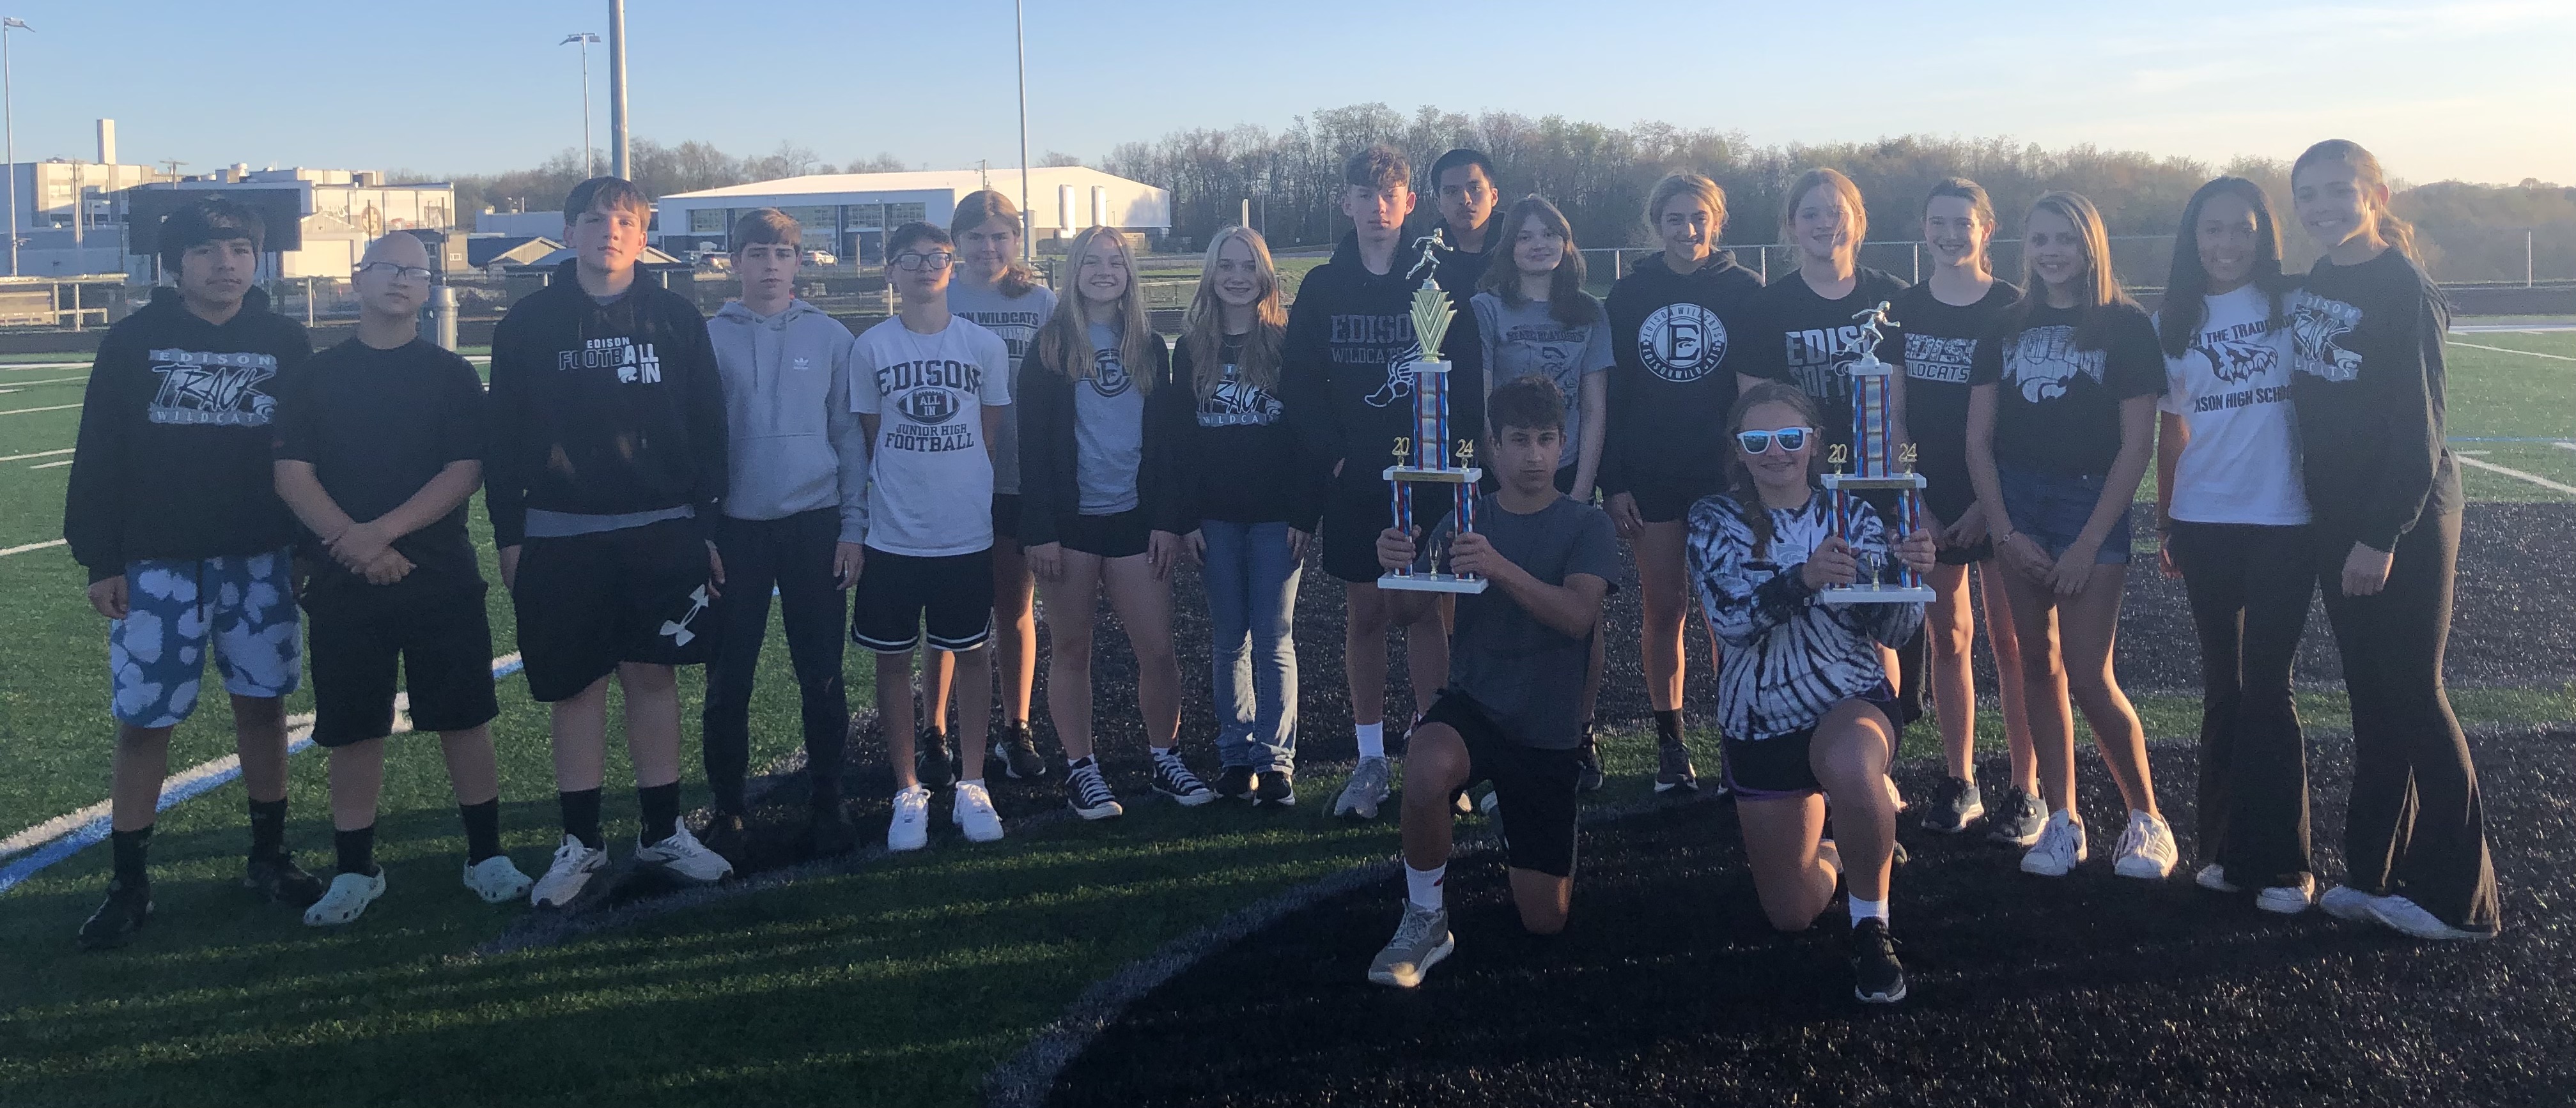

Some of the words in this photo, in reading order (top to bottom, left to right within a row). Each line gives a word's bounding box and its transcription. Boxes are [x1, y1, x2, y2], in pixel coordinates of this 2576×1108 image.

[2306, 296, 2356, 319] DISON
[977, 311, 1039, 326] WILDCATS
[1330, 313, 1418, 343] EDISO
[587, 337, 630, 349] EDISON
[1785, 325, 1871, 365] EDIS
[2205, 328, 2230, 344] THE
[159, 351, 271, 366] EDISON
[1331, 347, 1405, 364] WILDCATS
[640, 362, 662, 383] IN
[876, 359, 981, 396] EDISON
[1906, 361, 1971, 381] ILDCATS
[152, 362, 275, 412] TRACK
[919, 395, 941, 406] ALL
[2226, 389, 2253, 408] HIGH
[157, 410, 269, 424] WILDCATS
[924, 406, 936, 416] IN
[896, 423, 938, 436] JUNIOR
[940, 423, 967, 436] HIGH
[885, 433, 975, 452] FOOTBALL
[1392, 436, 1410, 456] 20
[1455, 438, 1474, 458] 24
[1827, 443, 1847, 463] 20
[1898, 442, 1918, 463] 24
